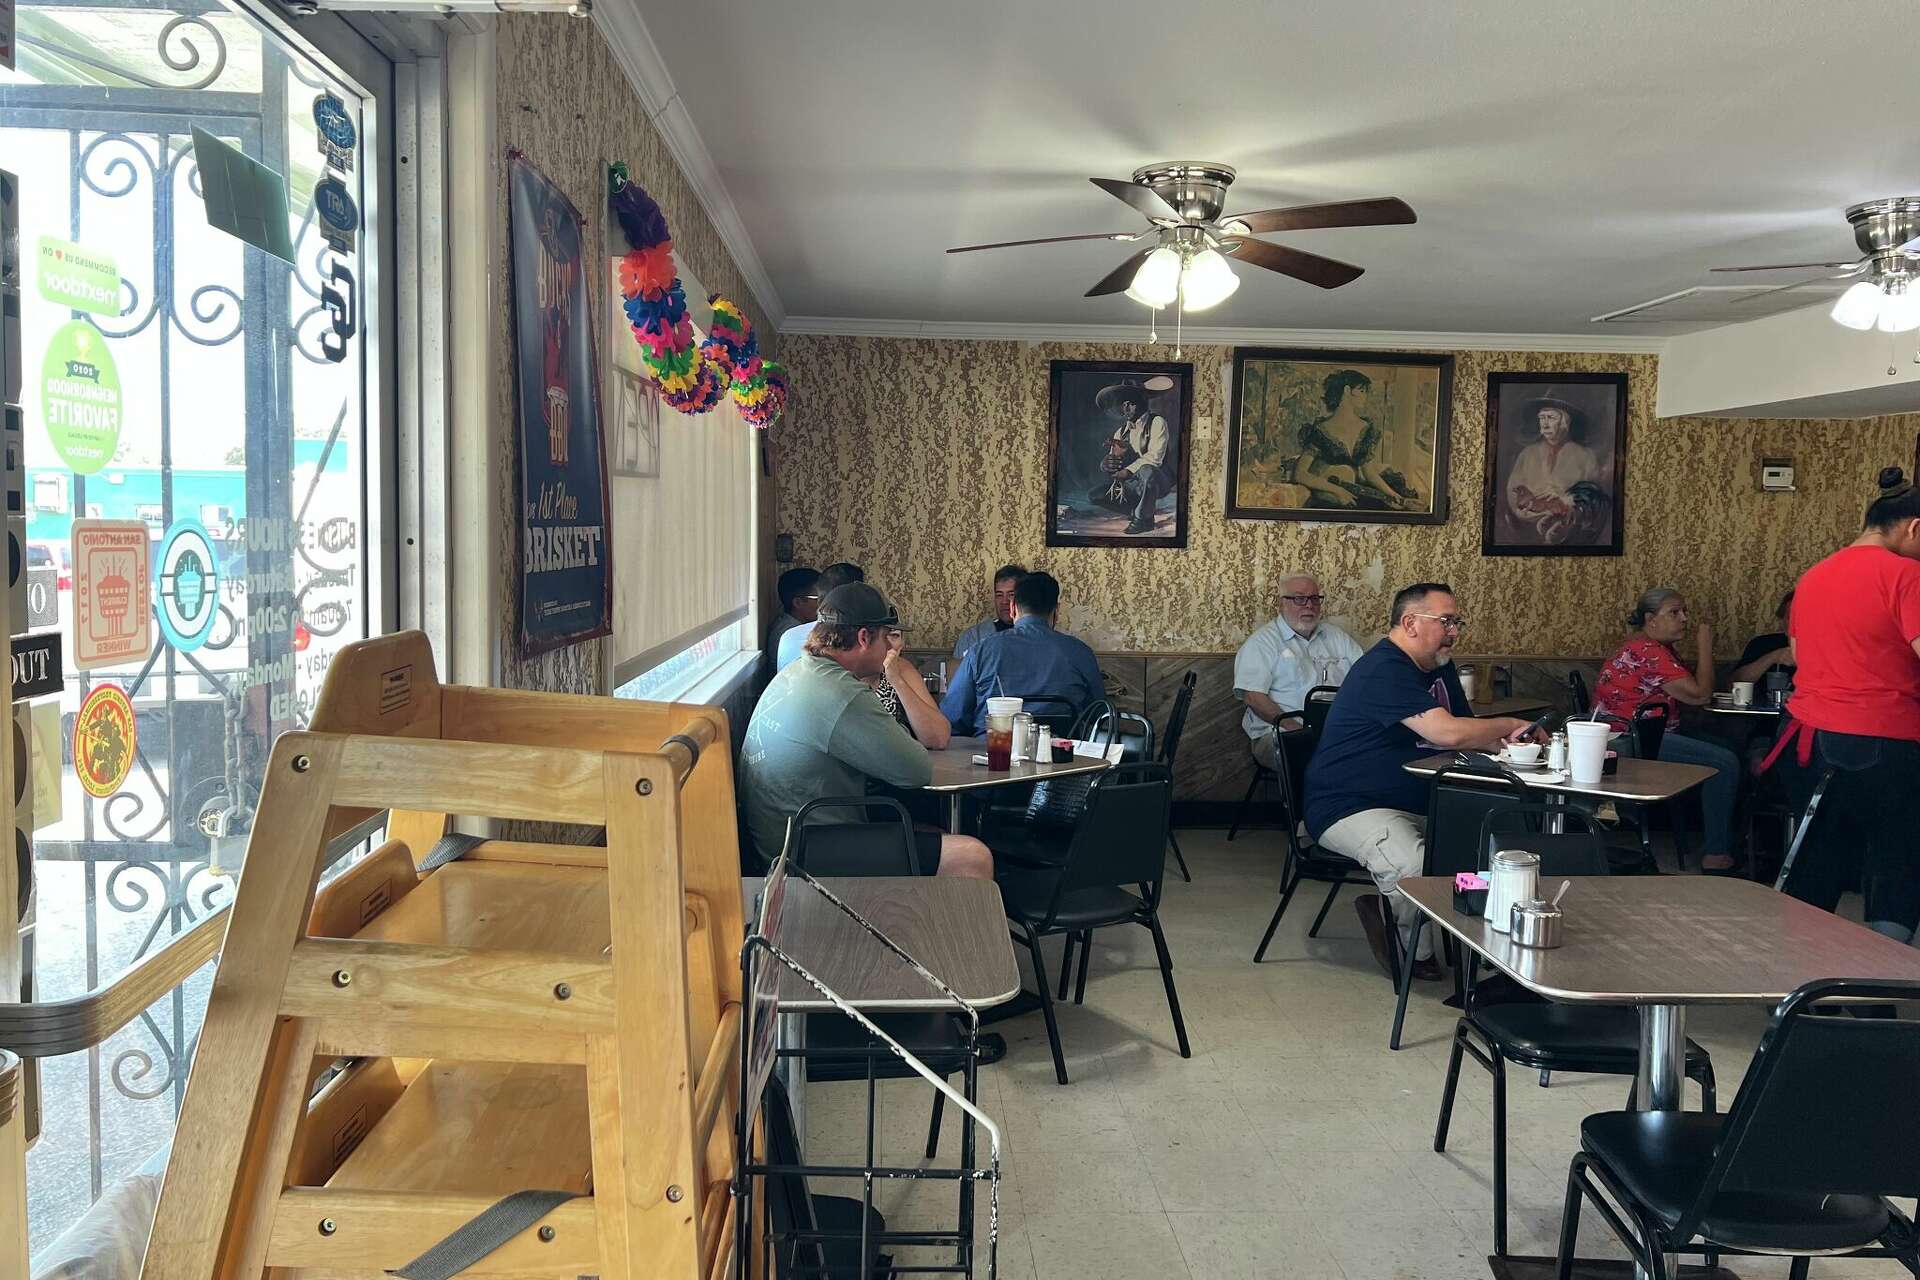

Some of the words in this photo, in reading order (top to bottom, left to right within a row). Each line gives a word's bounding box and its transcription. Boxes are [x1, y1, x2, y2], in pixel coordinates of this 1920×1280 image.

[538, 481, 553, 520] 1st
[554, 480, 579, 520] Place
[525, 526, 600, 574] BRISKET
[28, 582, 47, 614] O
